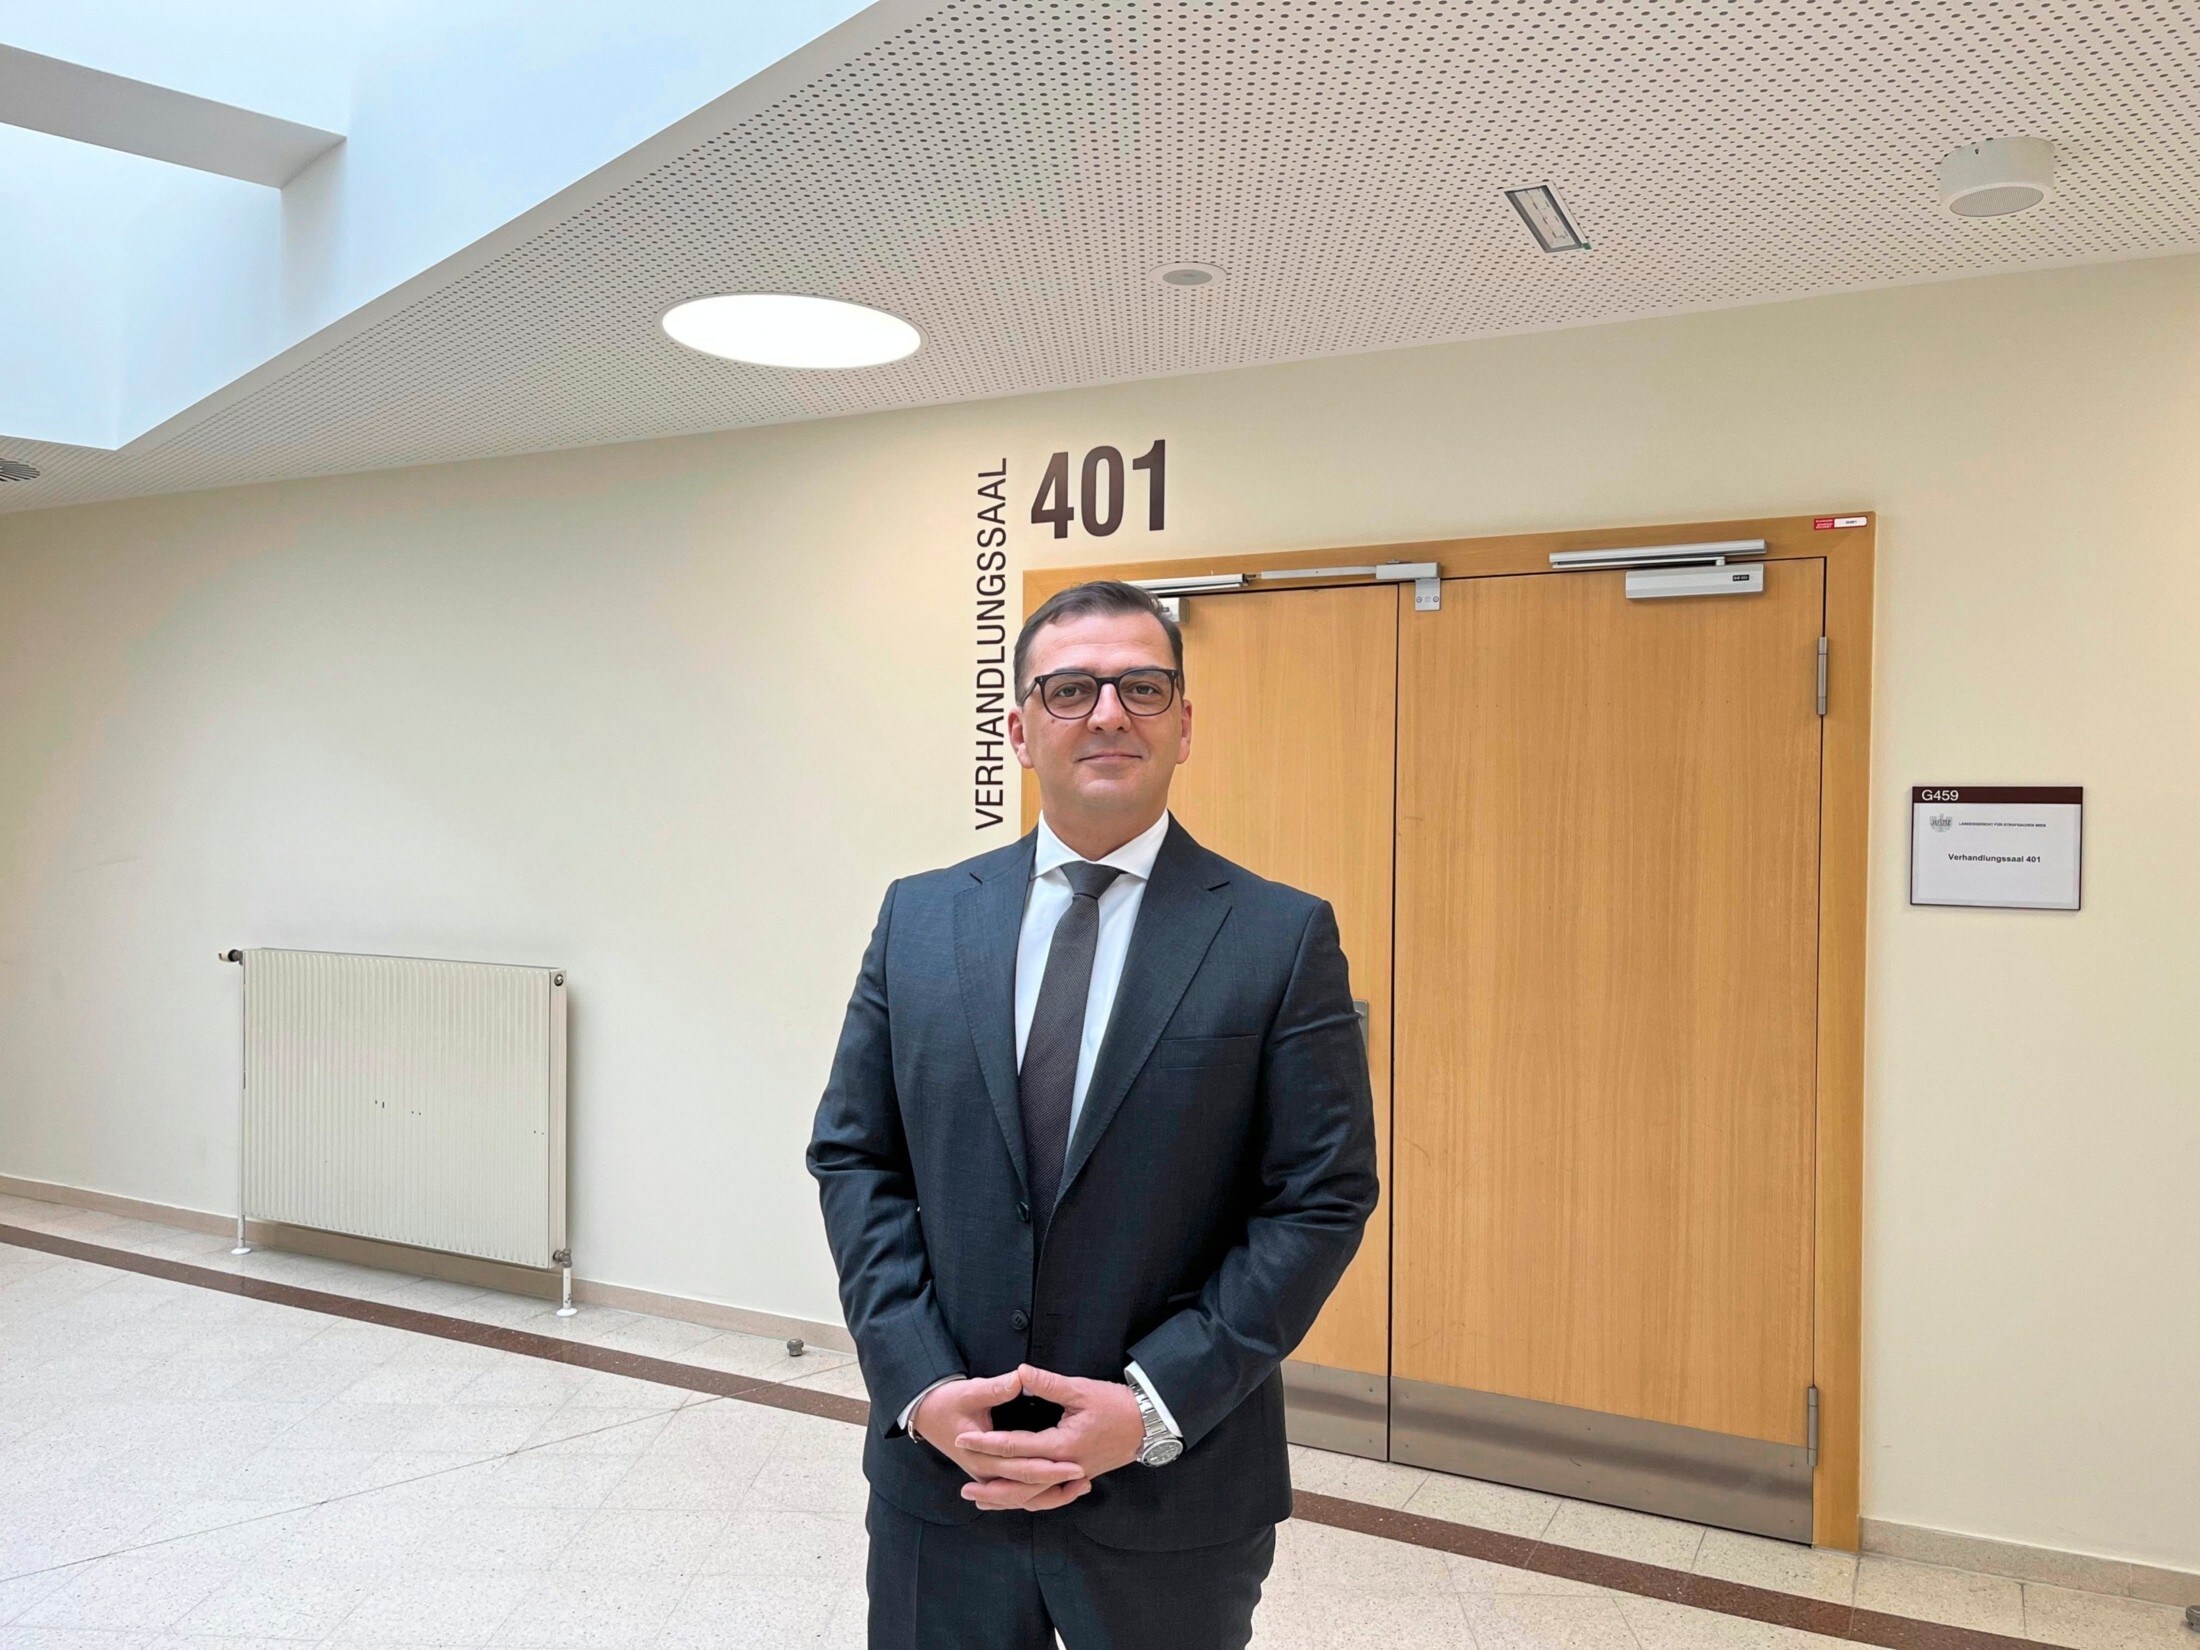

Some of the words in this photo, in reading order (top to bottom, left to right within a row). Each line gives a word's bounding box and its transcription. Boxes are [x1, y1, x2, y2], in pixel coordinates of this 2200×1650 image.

[1031, 439, 1166, 539] 401
[975, 457, 1007, 831] VERHANDLUNGSSAAL
[1921, 789, 1959, 802] G459
[1948, 853, 2024, 864] Verhandlungssaal
[2025, 855, 2041, 863] 401
